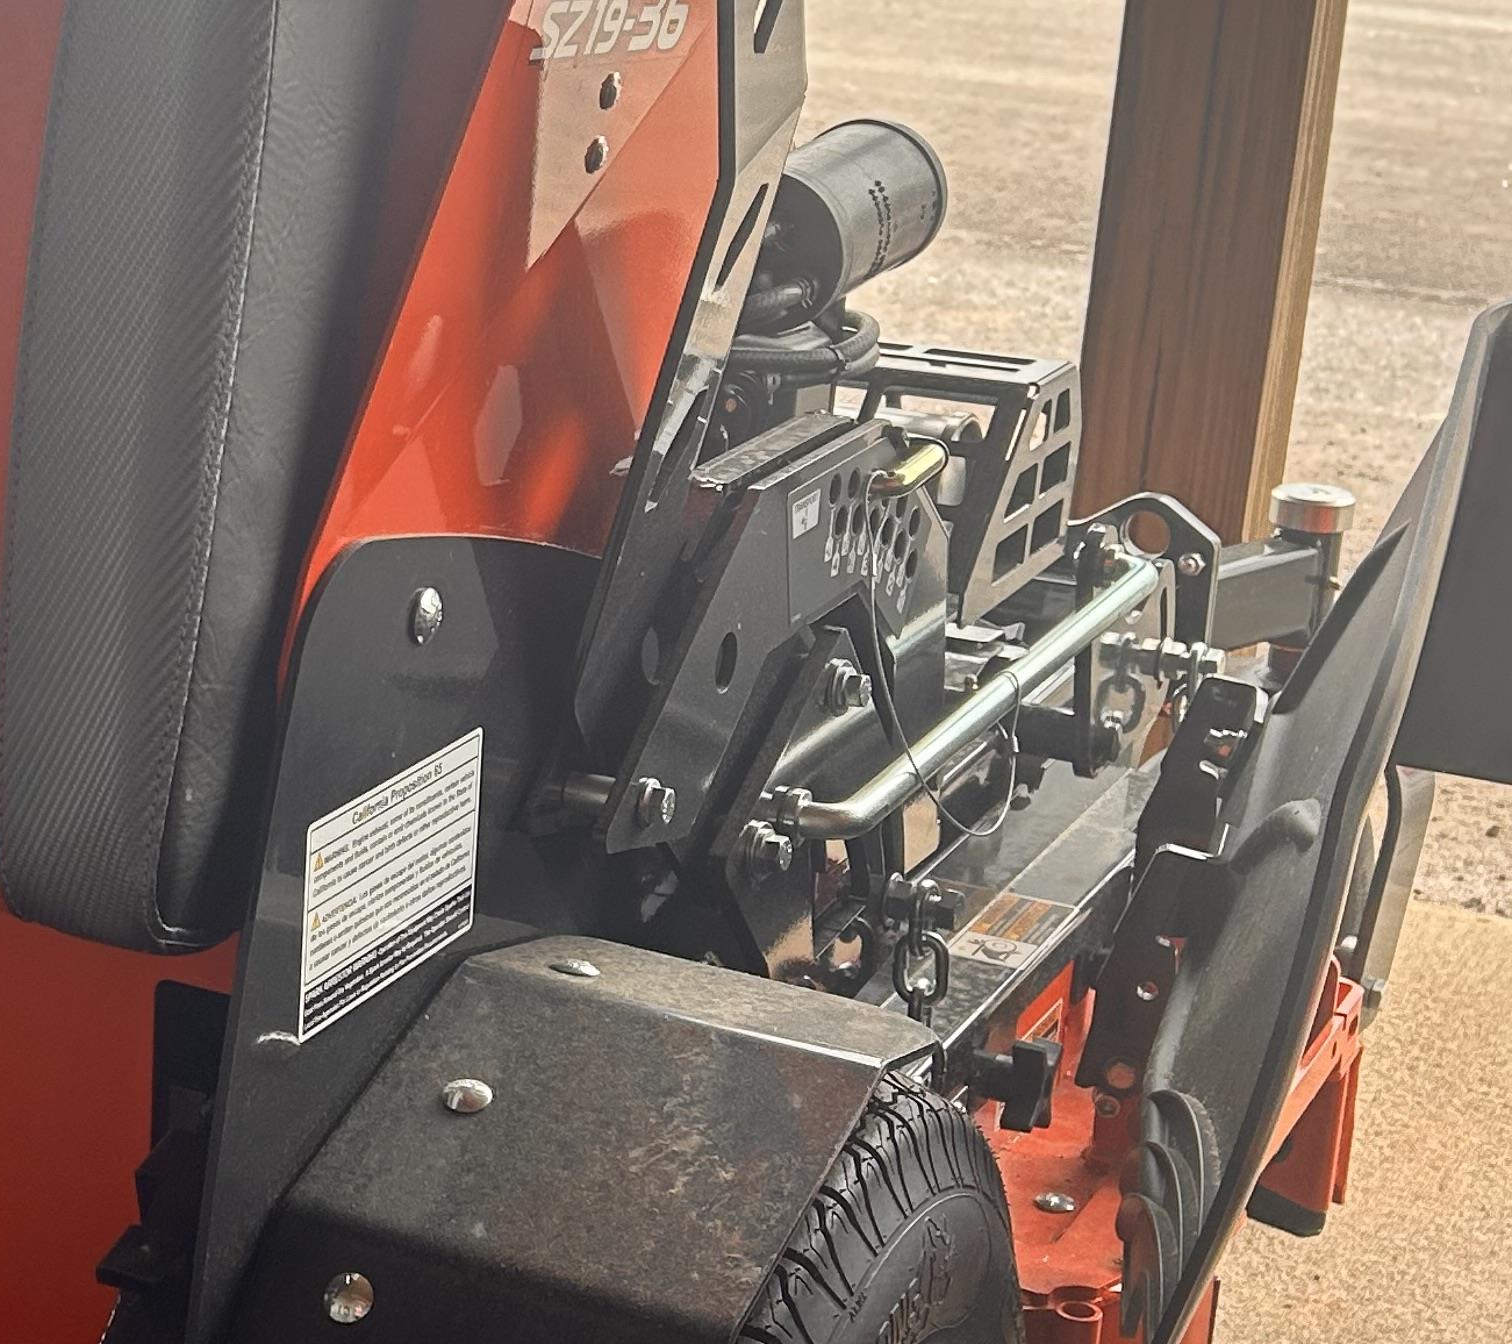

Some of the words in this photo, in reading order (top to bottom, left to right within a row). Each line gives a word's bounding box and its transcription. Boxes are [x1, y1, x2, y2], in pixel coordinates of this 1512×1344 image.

[351, 792, 388, 826] California
[390, 767, 432, 807] Proposition
[433, 760, 442, 778] 65
